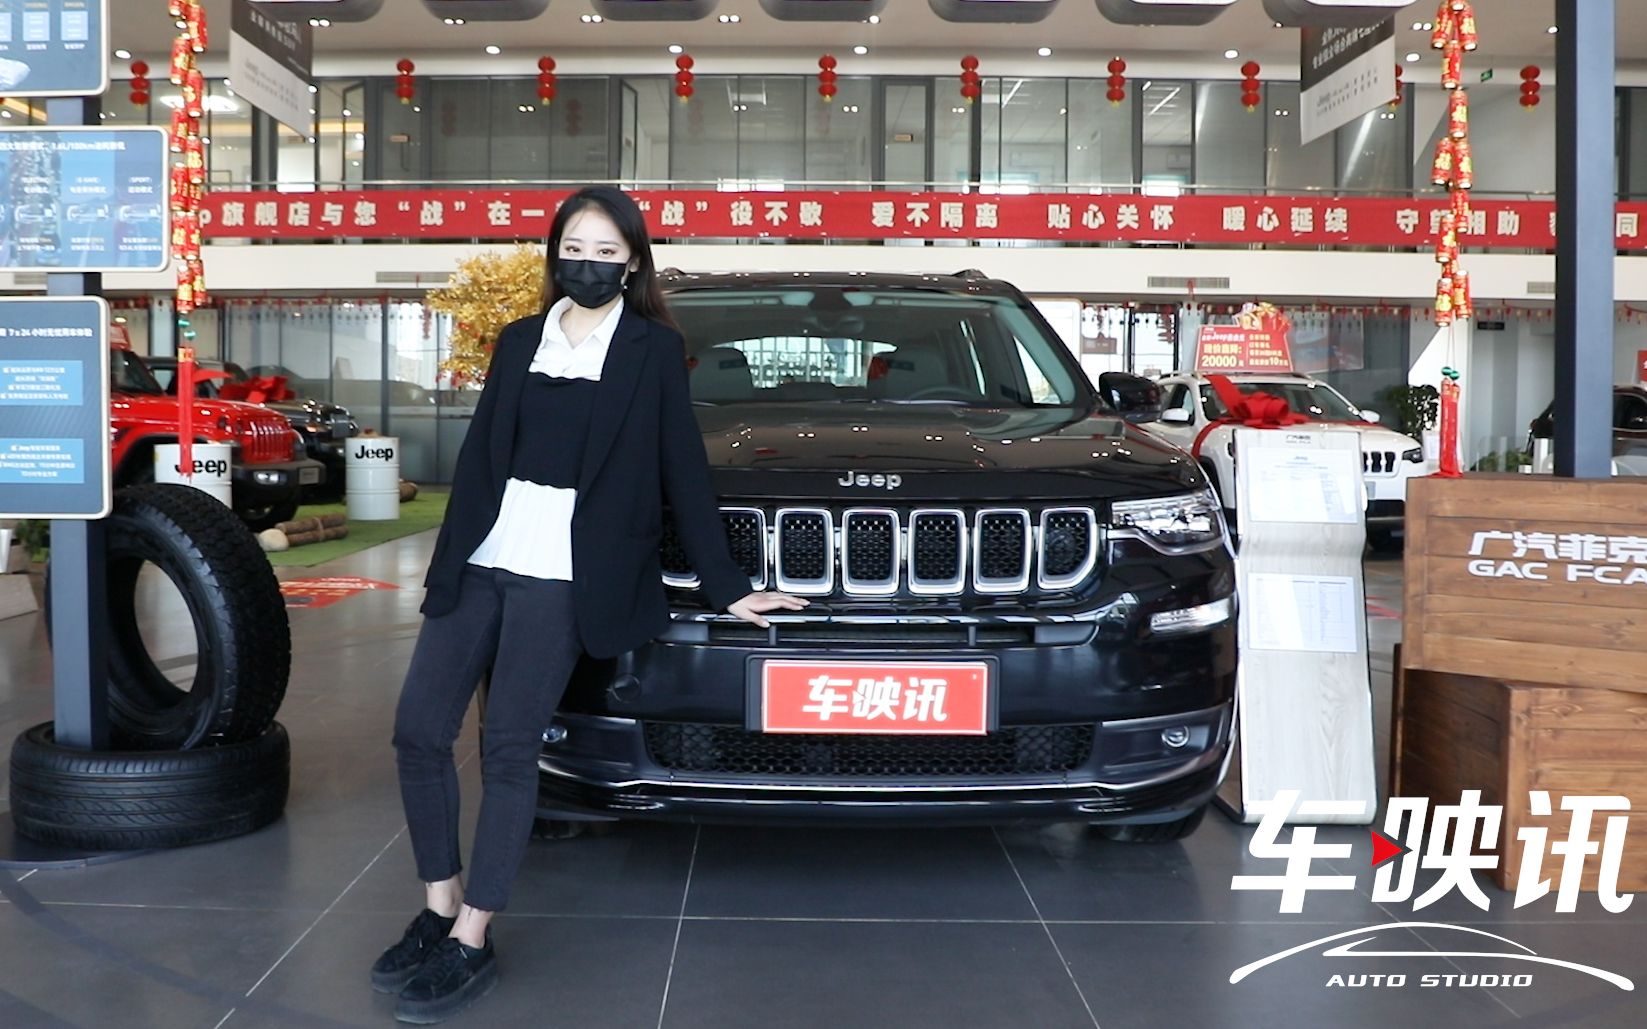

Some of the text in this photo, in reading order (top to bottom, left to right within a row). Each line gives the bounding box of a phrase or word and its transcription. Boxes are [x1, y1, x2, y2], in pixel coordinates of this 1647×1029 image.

[872, 202, 999, 229] 爱不隔离
[1047, 204, 1174, 231] 贴心关怀
[1222, 206, 1349, 233] 暖心延续
[355, 445, 393, 461] Jeep
[838, 470, 902, 490] Jeep
[1468, 530, 1647, 564] 广汽菲克
[1468, 559, 1647, 585] GAC FCA
[802, 674, 948, 722] 车映讯
